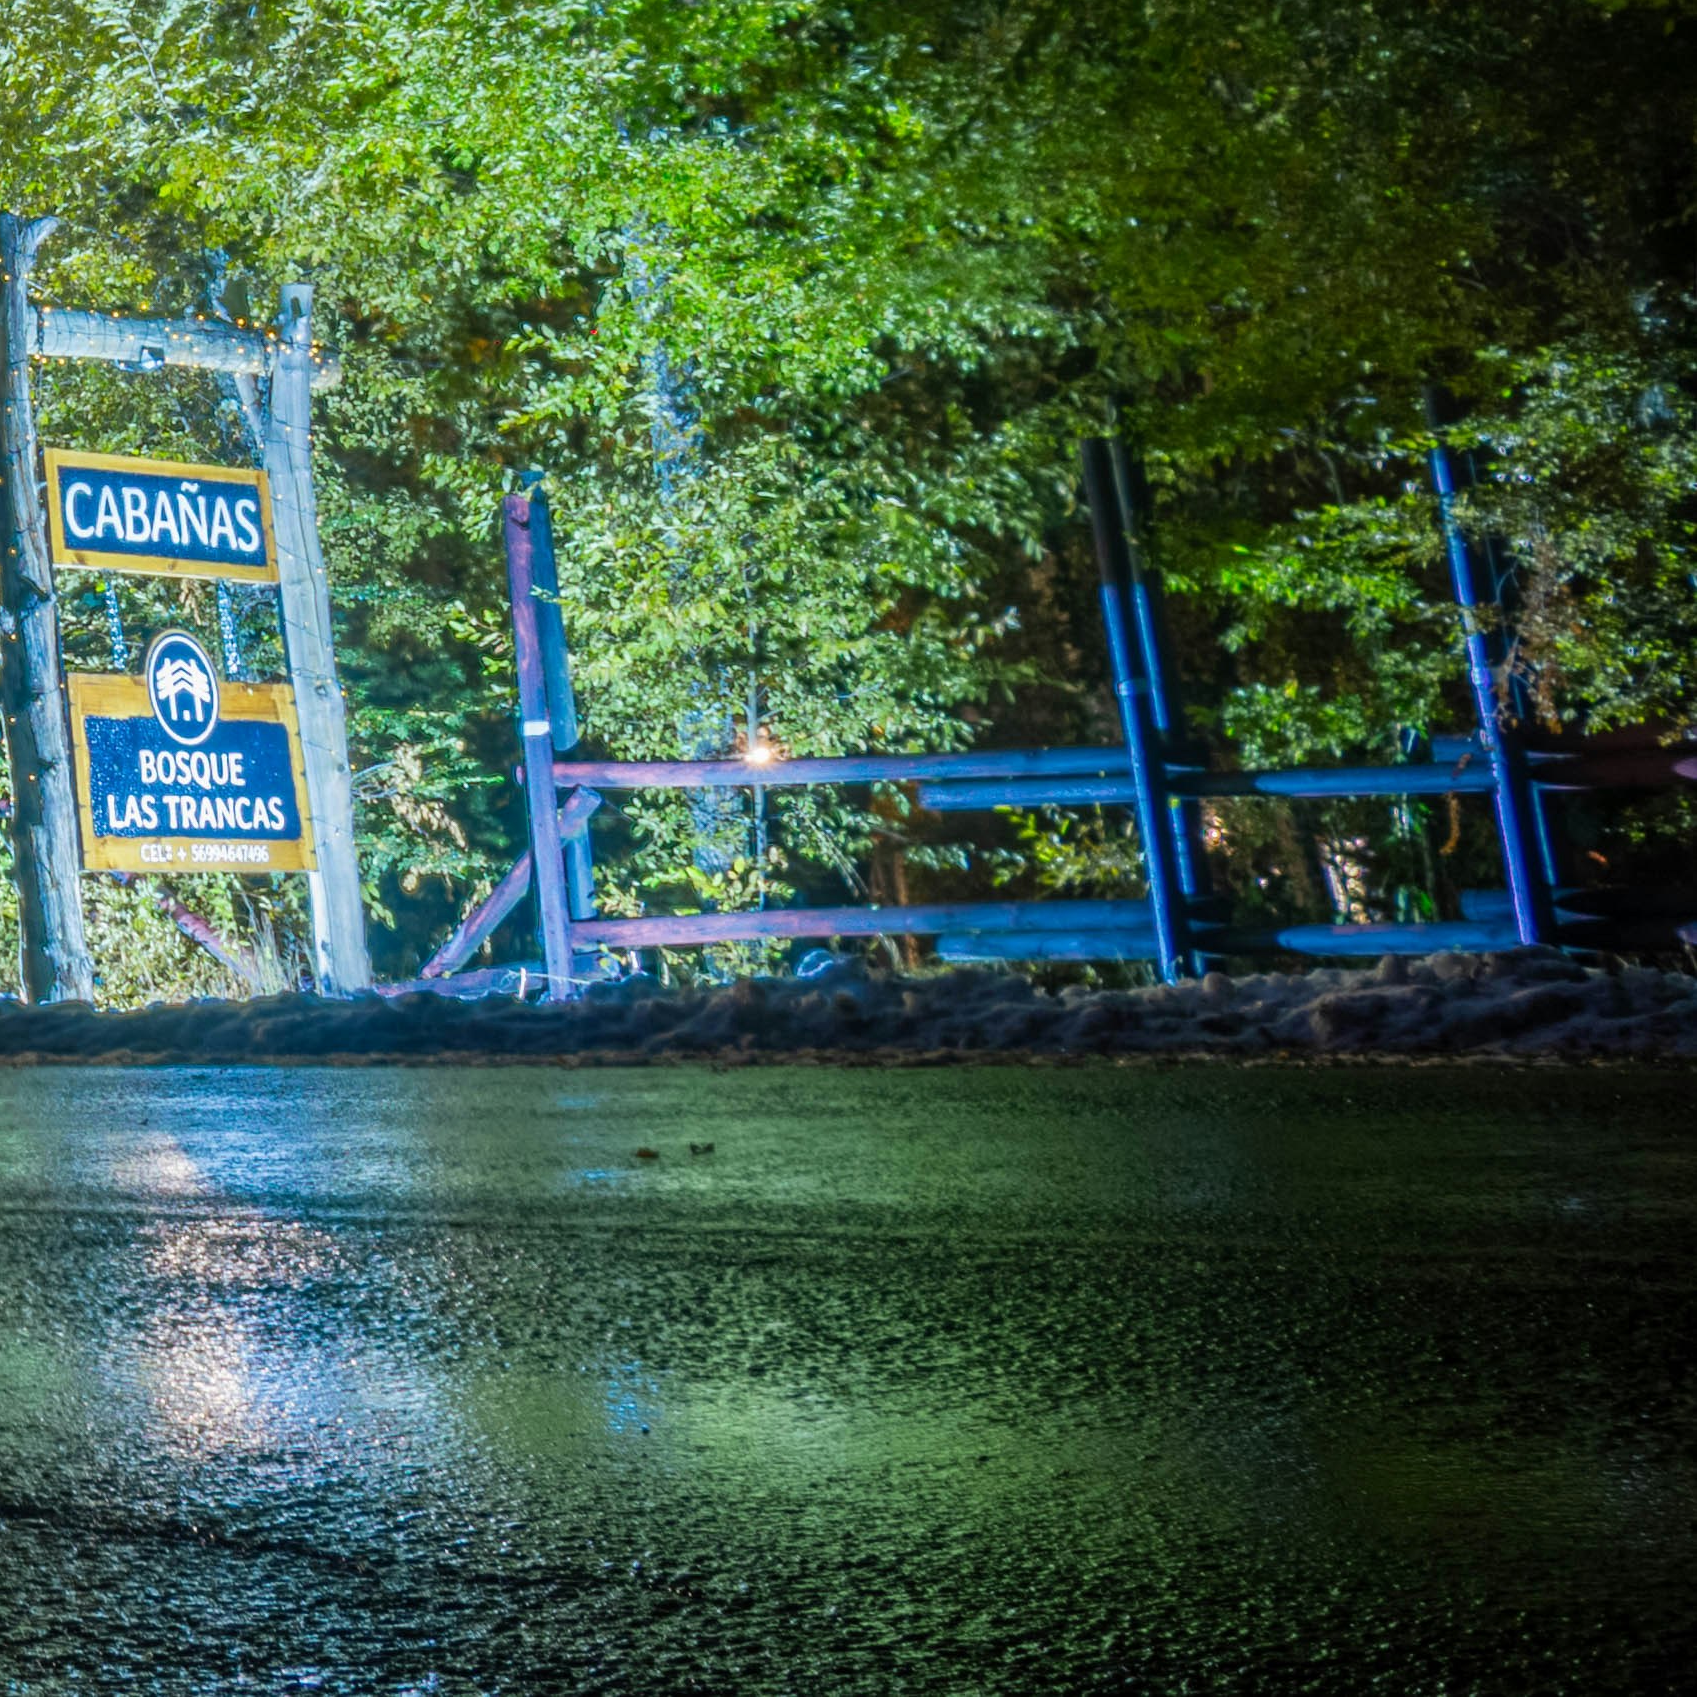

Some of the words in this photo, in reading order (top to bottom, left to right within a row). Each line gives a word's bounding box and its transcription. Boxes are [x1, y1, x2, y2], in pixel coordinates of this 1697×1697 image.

[64, 480, 261, 553] CABAÑAS
[138, 749, 245, 787] BOSQUE
[107, 794, 158, 829] LAS
[162, 796, 286, 832] TRANCAS
